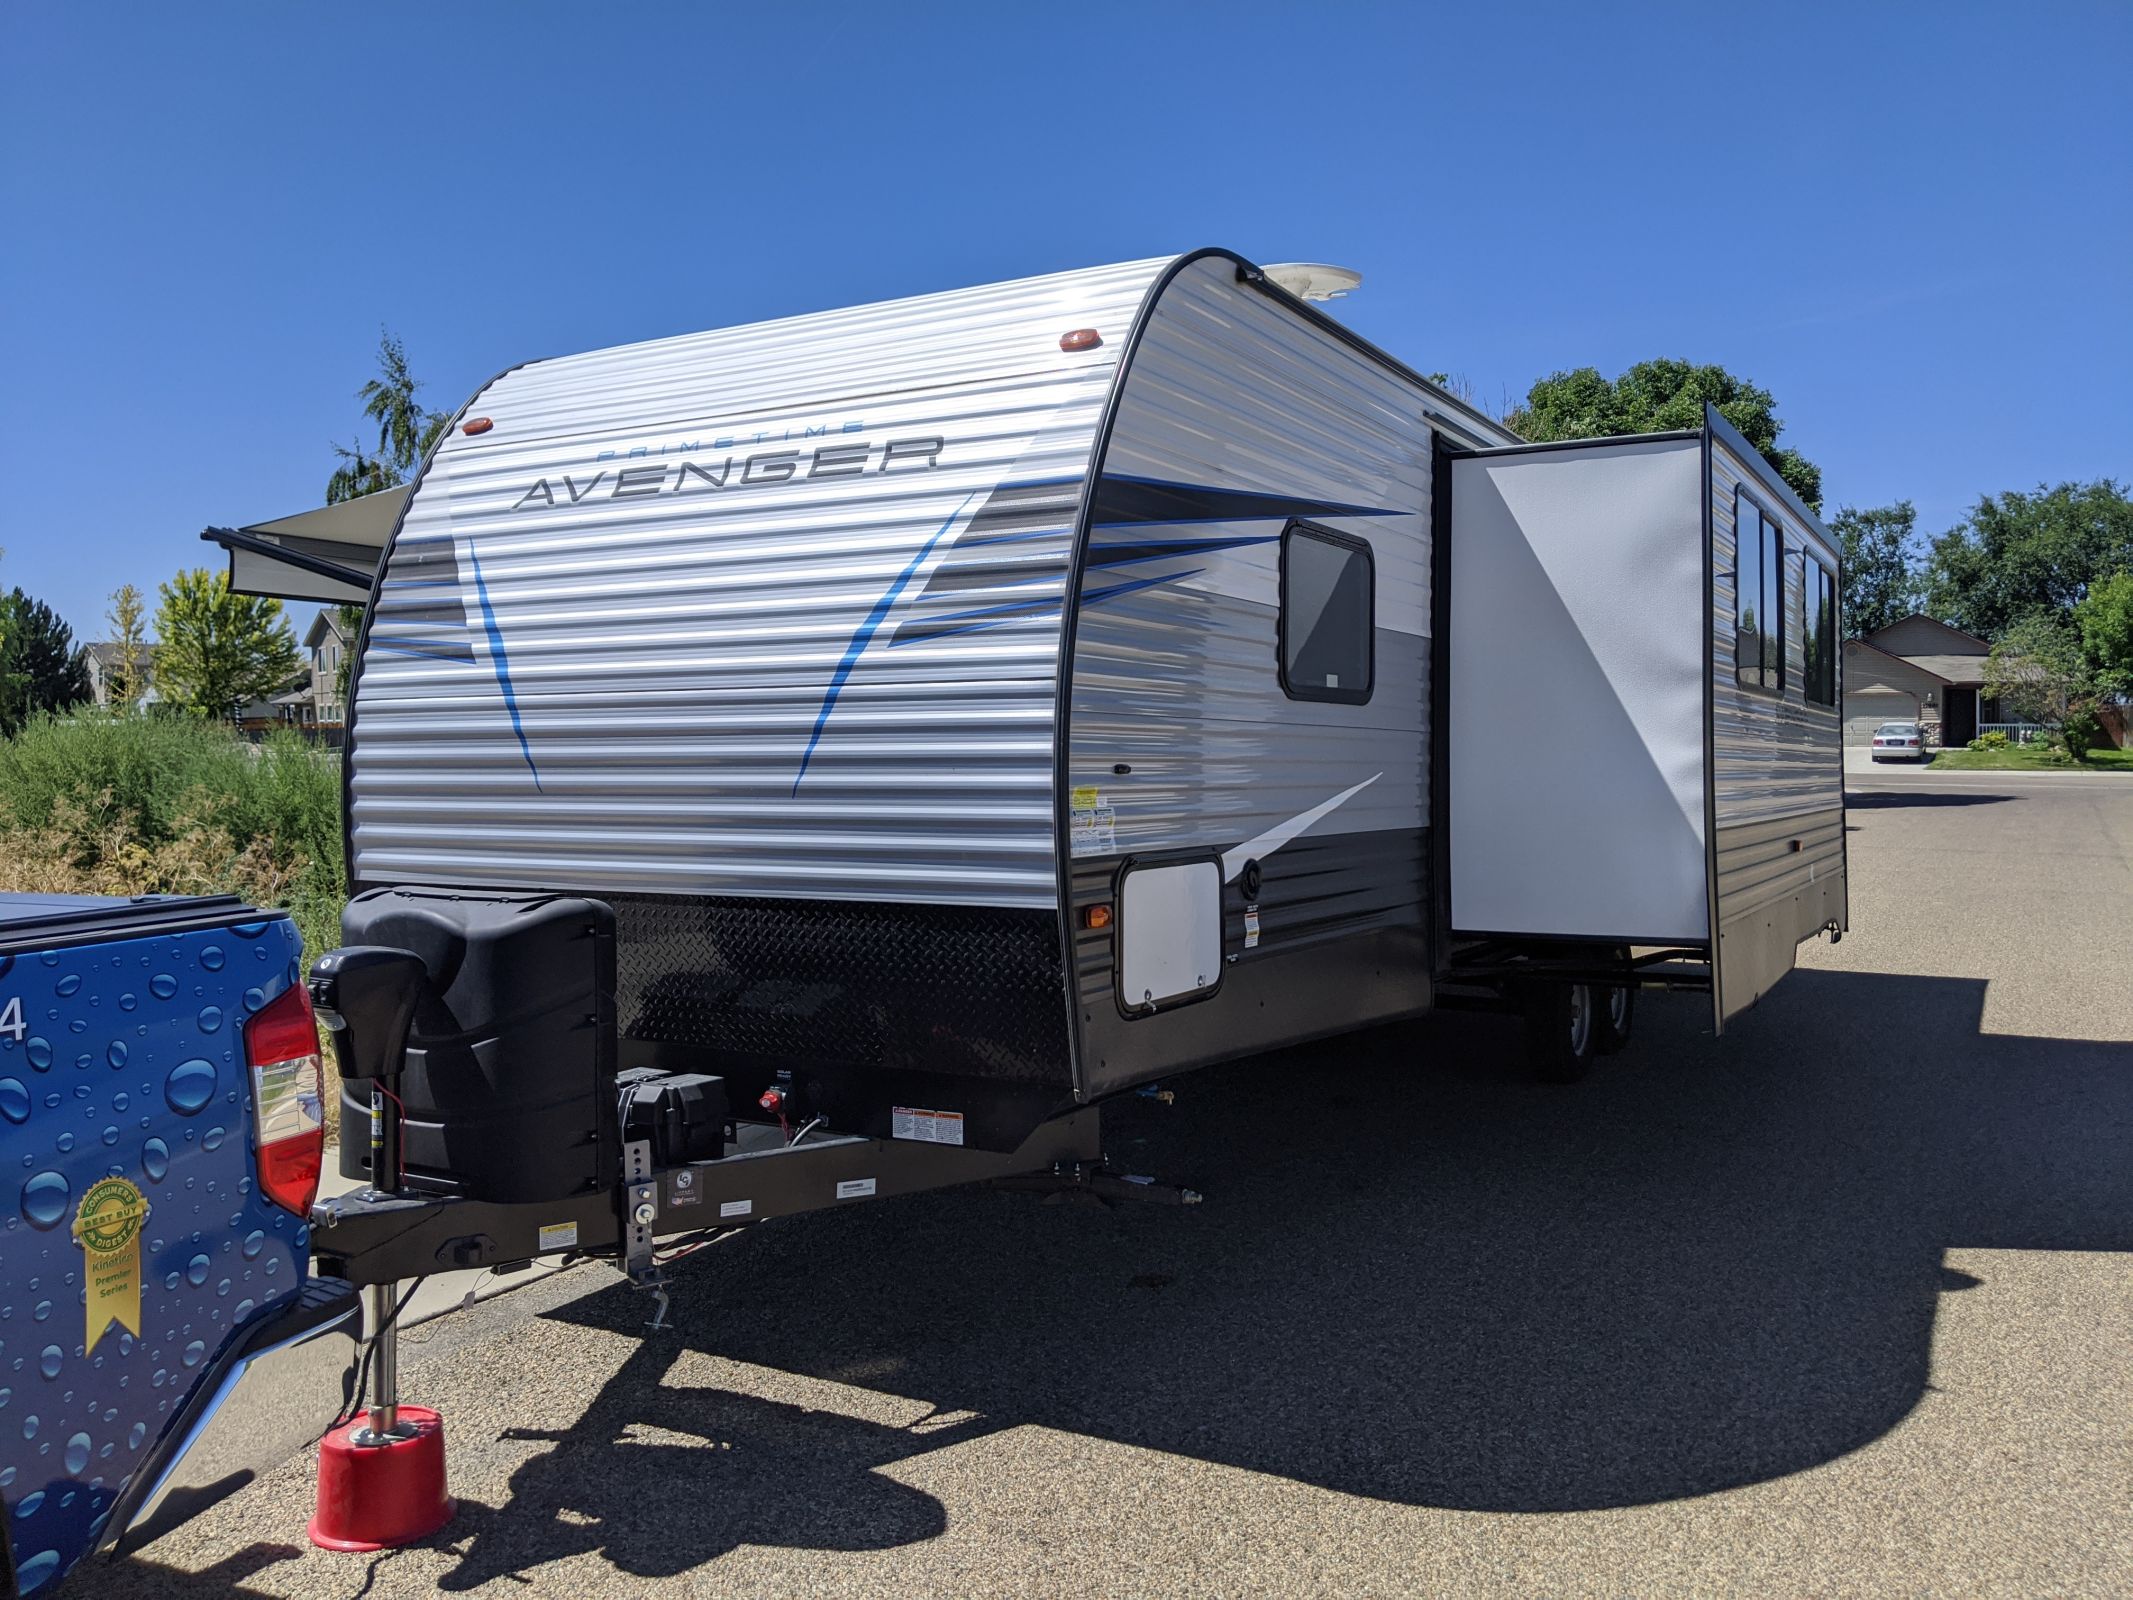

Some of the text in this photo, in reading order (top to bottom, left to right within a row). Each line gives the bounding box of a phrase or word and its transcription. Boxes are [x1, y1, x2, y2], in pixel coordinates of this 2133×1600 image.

[510, 435, 945, 512] AVENGER
[0, 996, 27, 1041] 4
[86, 1186, 133, 1213] CONSUMERS
[84, 1206, 137, 1228] BEST BUY
[96, 1230, 128, 1248] DIGEST
[99, 1282, 128, 1298] Series
